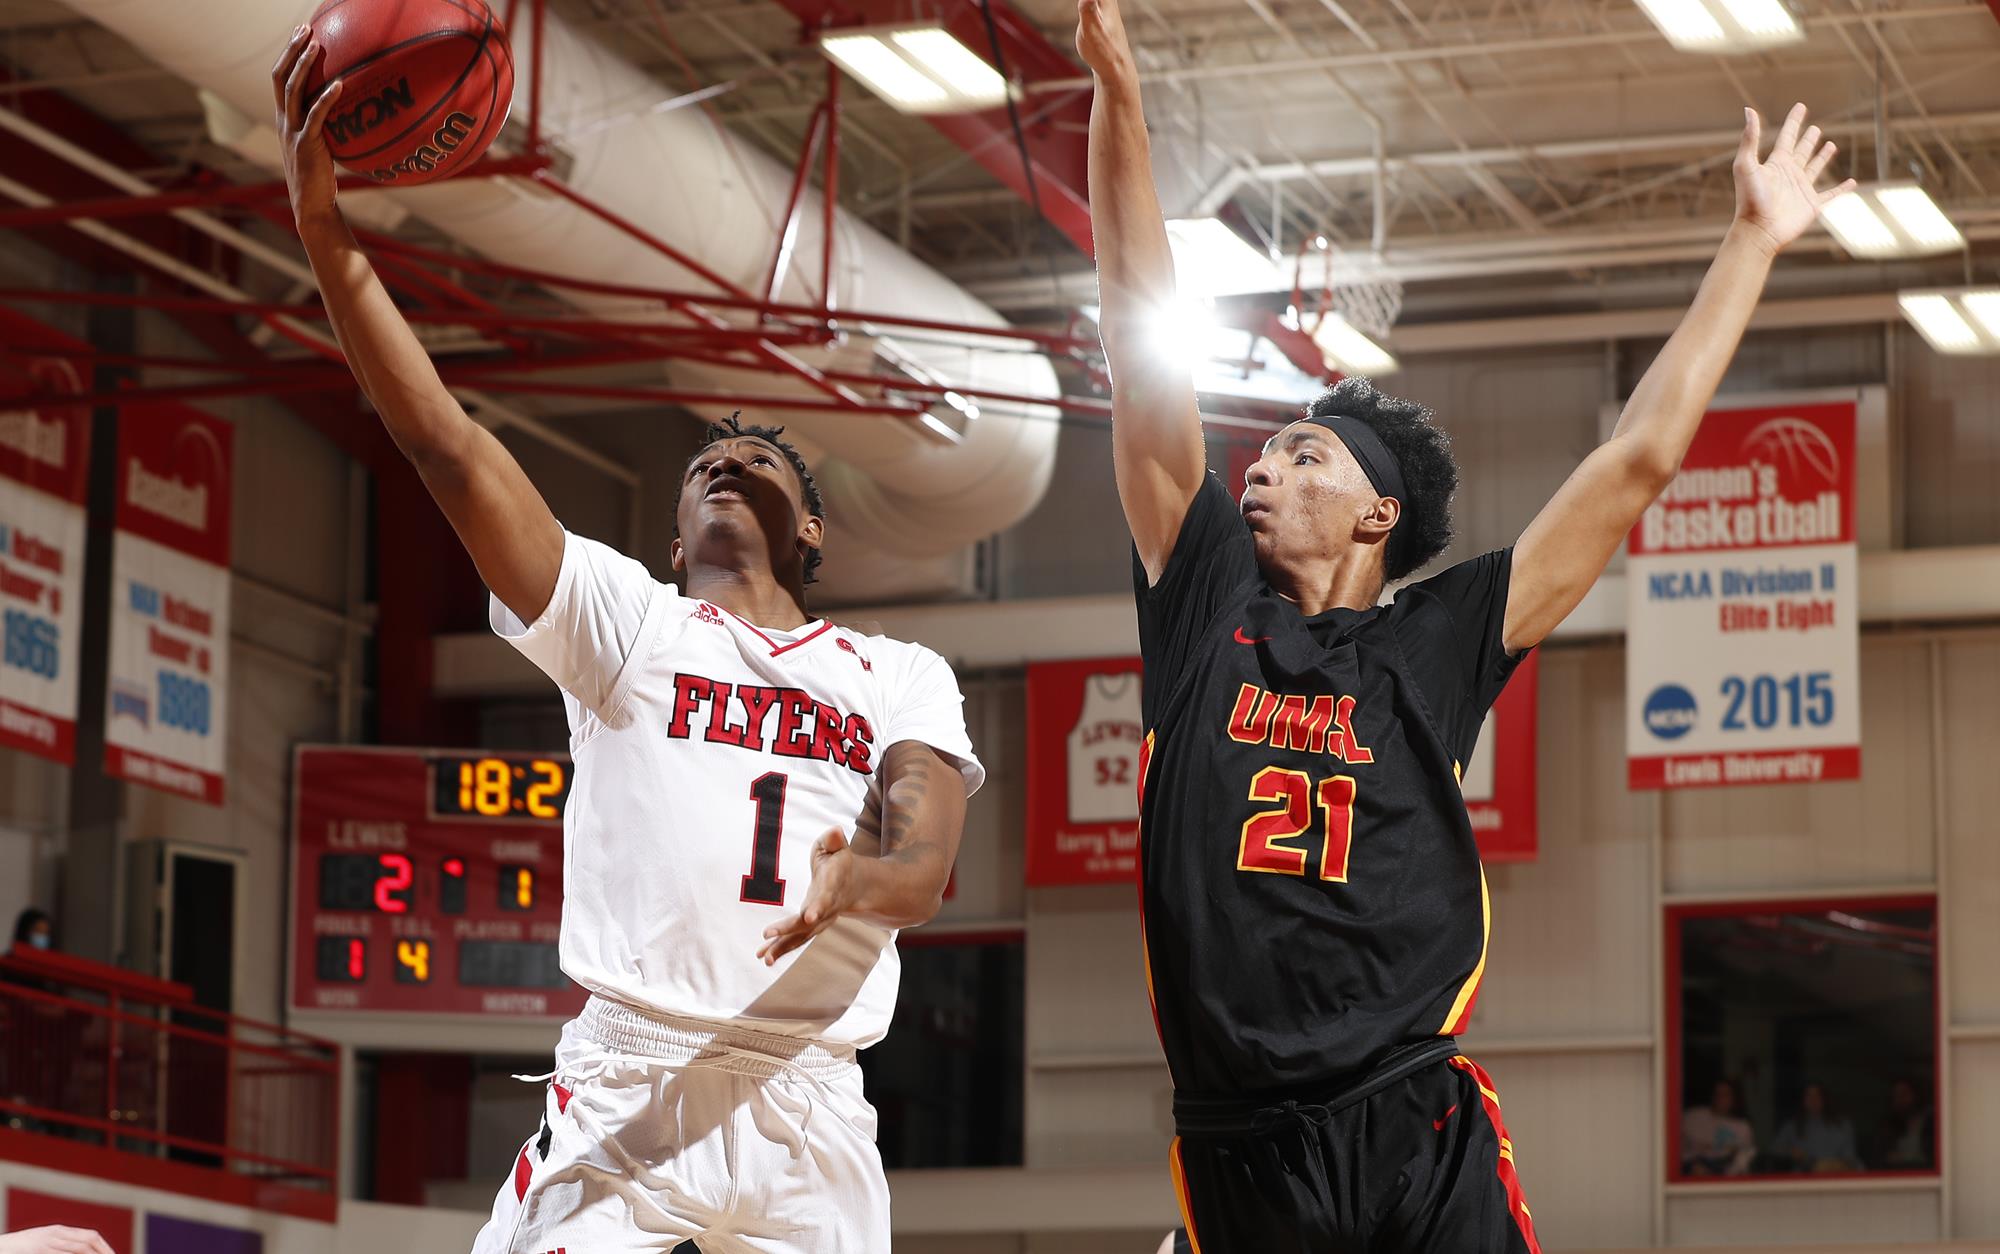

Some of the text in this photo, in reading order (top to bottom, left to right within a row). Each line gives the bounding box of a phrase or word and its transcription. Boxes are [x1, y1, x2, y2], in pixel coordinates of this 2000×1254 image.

[326, 76, 416, 146] NCAA
[371, 111, 479, 182] Wilso
[1661, 457, 1777, 501] omen's
[1643, 491, 1840, 550] Basketball
[1649, 571, 1712, 600] NCAA
[1720, 567, 1813, 597] Division
[1719, 599, 1835, 633] Elite Eight
[667, 672, 875, 776] FLYERS
[1720, 672, 1835, 732] 2015
[458, 758, 564, 818] 18:2
[1095, 755, 1131, 786] 52
[1664, 751, 1824, 785] Lewis University
[328, 821, 406, 849] LEWIS
[739, 771, 788, 906] 1
[1237, 765, 1357, 883] 21
[373, 853, 413, 913] 2
[516, 867, 533, 908] 1
[348, 939, 365, 981] 1
[397, 939, 430, 981] 4
